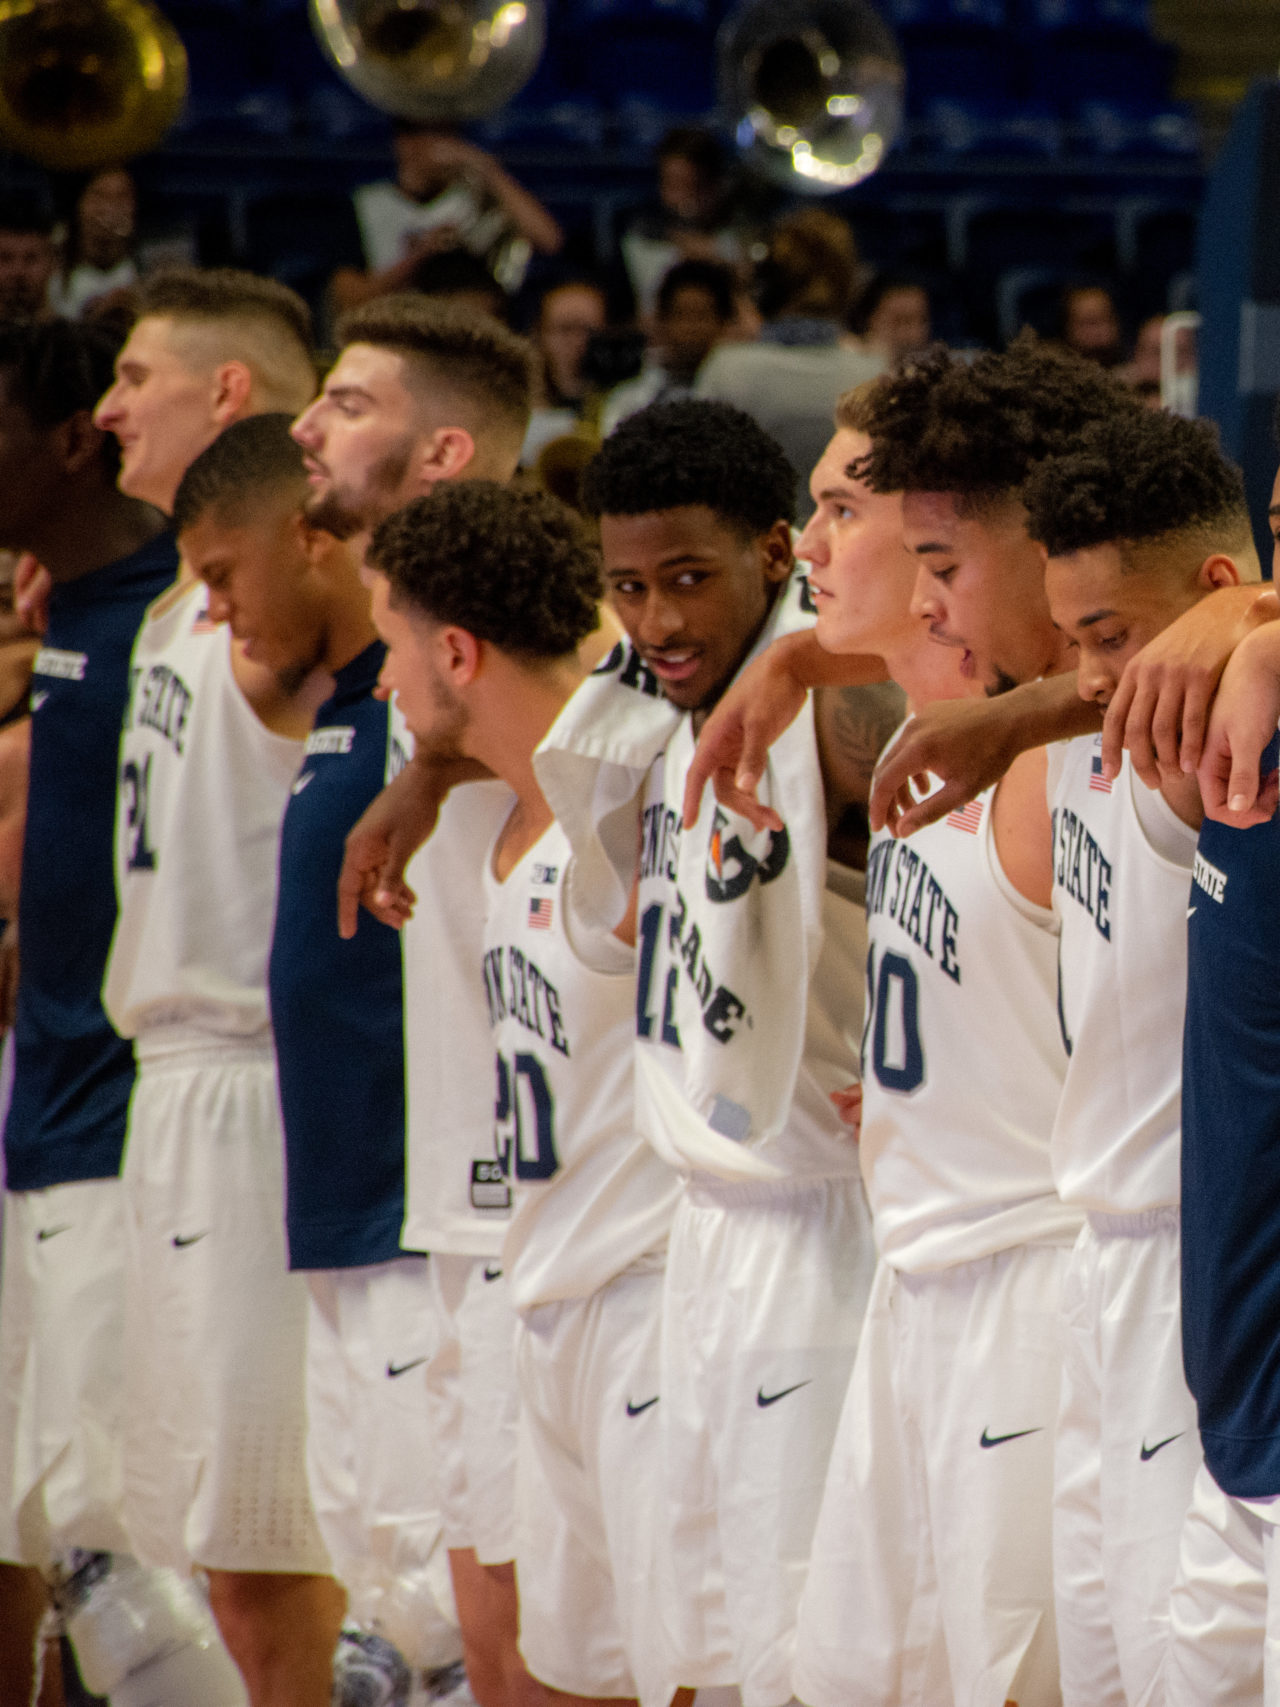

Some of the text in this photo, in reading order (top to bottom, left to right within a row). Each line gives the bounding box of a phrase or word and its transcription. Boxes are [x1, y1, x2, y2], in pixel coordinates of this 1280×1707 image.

[889, 842, 961, 986] STATE
[1057, 806, 1113, 944] STATE
[507, 944, 571, 1059] STATE
